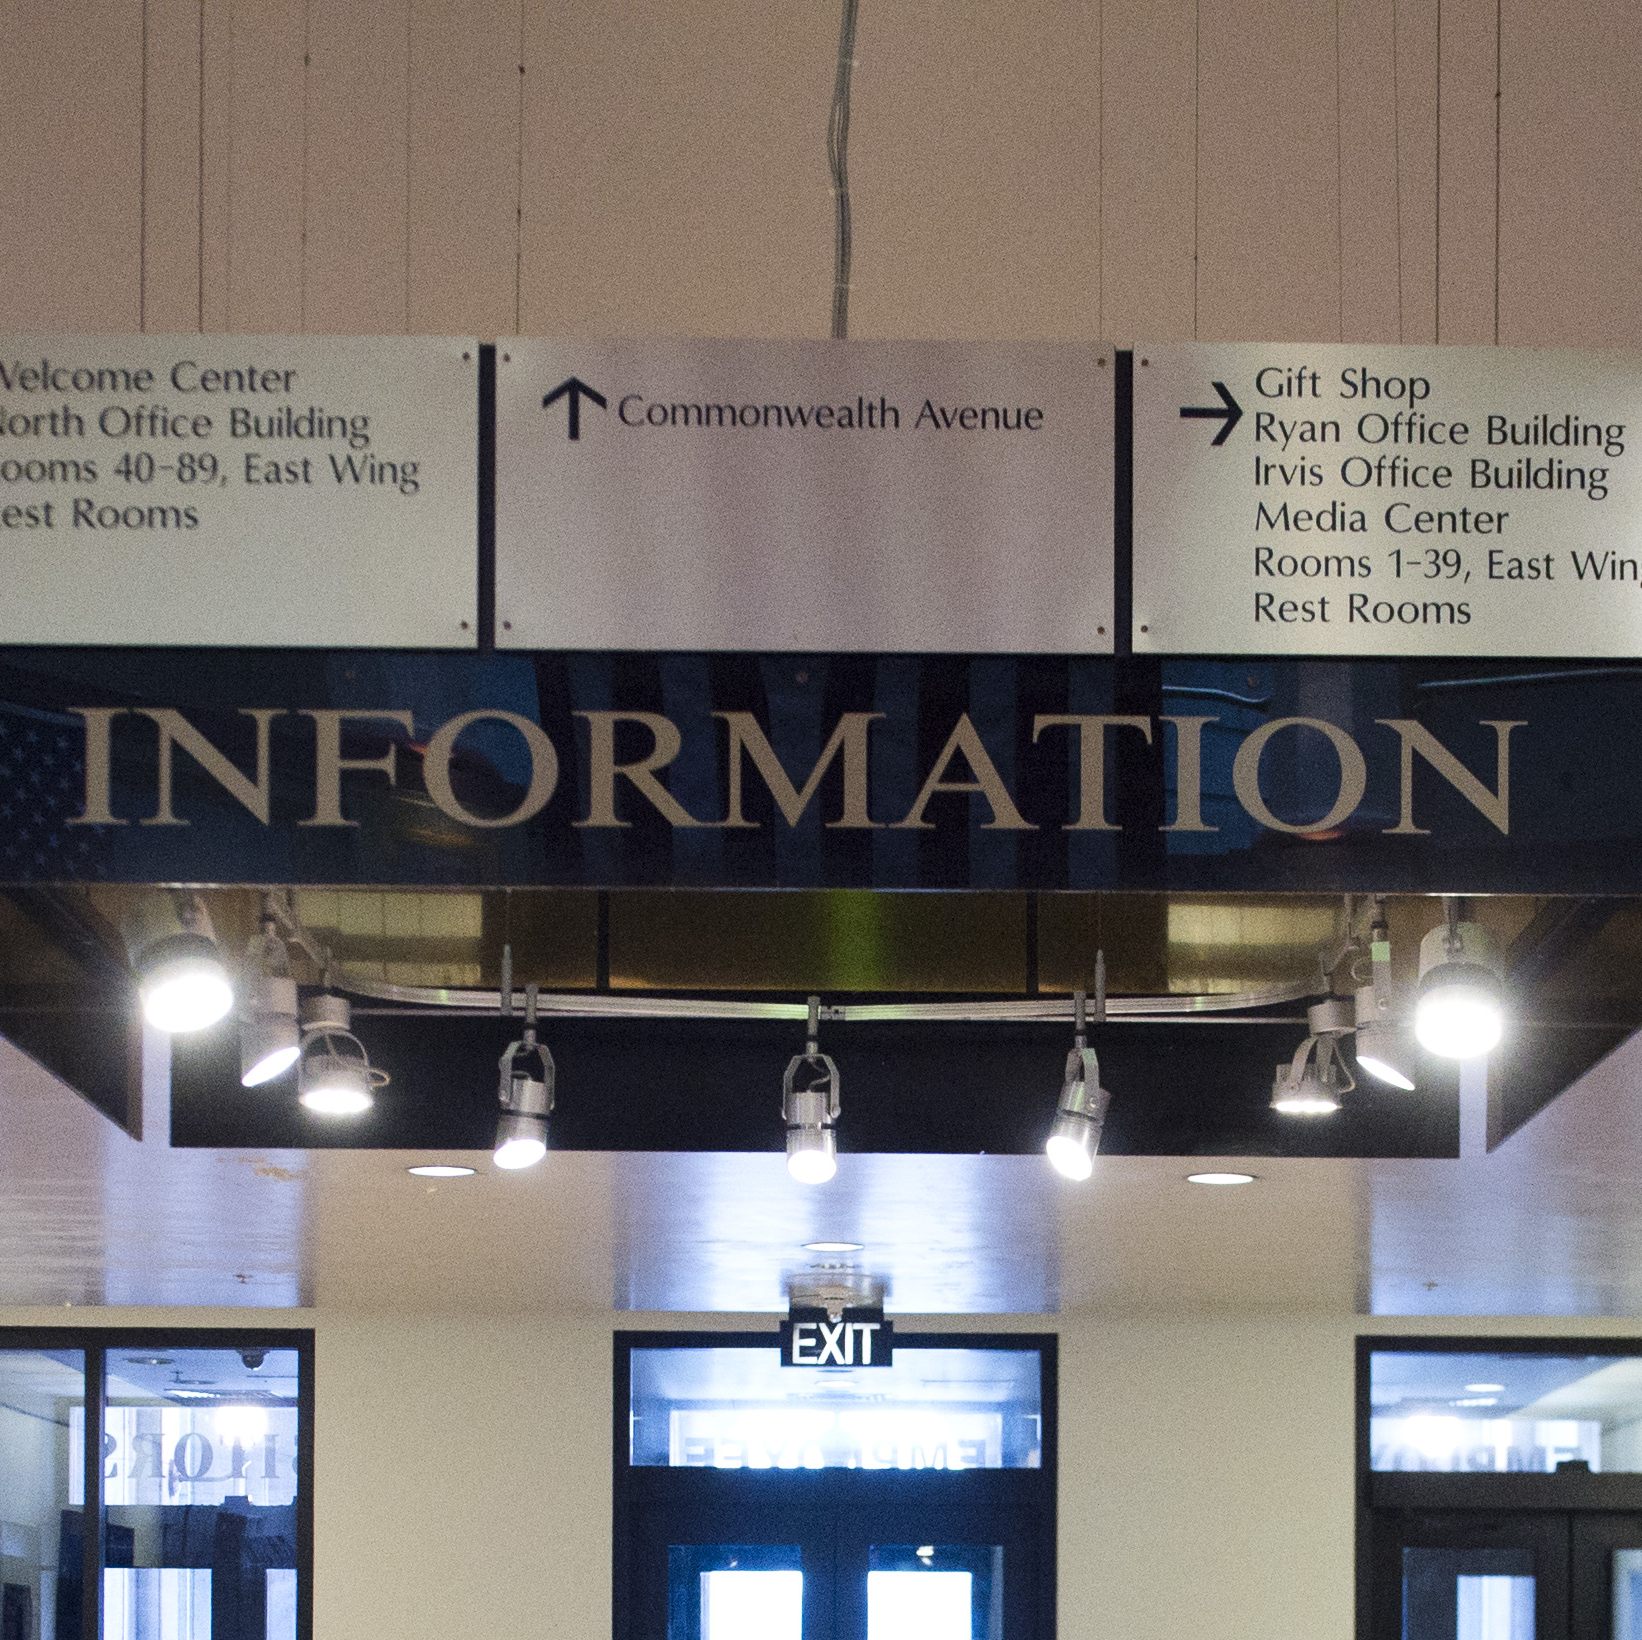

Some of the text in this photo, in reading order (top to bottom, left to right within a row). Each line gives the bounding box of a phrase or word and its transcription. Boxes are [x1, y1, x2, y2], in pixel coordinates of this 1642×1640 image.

[169, 360, 298, 393] Center
[1254, 365, 1432, 408] Gift Shop
[97, 404, 214, 439] Office
[229, 406, 372, 448] Building
[616, 394, 1046, 432] Commonwealth Avenue
[1253, 410, 1627, 458] Ryan Office Building
[113, 451, 230, 489] 40-89,
[243, 453, 314, 485] East
[328, 453, 421, 495] Wing
[1253, 454, 1610, 501] Irvis Office Building
[71, 497, 200, 530] Rooms
[1253, 499, 1511, 535] Media Center
[1253, 546, 1373, 579] Rooms
[1387, 548, 1472, 585] 1-39,
[1486, 548, 1556, 582] East
[1253, 591, 1473, 626] Rest Rooms
[62, 706, 1529, 838] INFORMATION
[791, 1321, 882, 1366] EXIT
